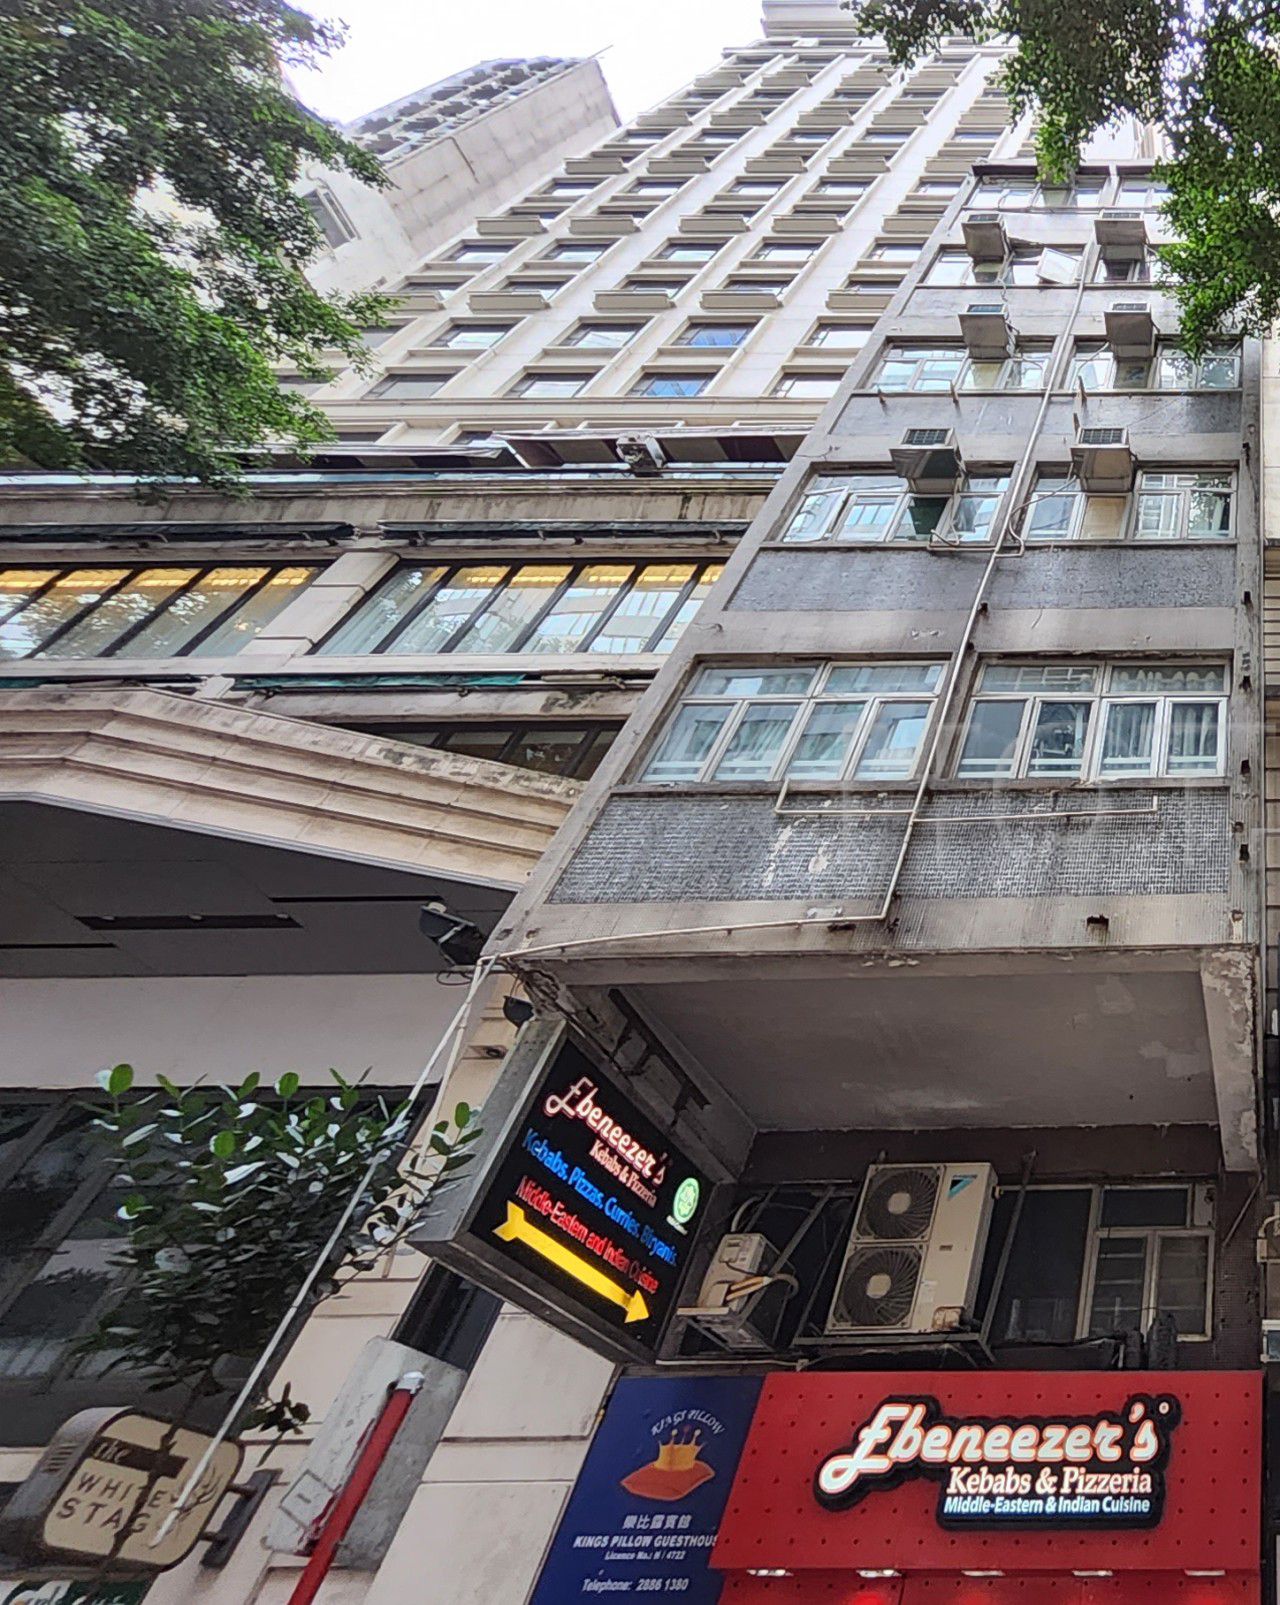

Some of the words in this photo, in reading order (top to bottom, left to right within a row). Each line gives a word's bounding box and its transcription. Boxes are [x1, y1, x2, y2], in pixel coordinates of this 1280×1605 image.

[544, 1076, 667, 1187] Ebeneezer's
[588, 1138, 622, 1177] Kebabs
[618, 1164, 630, 1184] &
[626, 1170, 658, 1209] Pizzeria
[515, 1175, 589, 1245] Middle-Eastern
[586, 1231, 607, 1257] and
[602, 1240, 631, 1274] Indian
[687, 1408, 726, 1435] PILLOW
[818, 1401, 1159, 1494] Ebeneezer's
[946, 1466, 1032, 1495] Kebabs
[1034, 1466, 1059, 1495] &
[1060, 1466, 1153, 1495] Pizzeria
[943, 1496, 1044, 1514] Middle-Eastern
[1044, 1496, 1059, 1513] &
[1058, 1496, 1100, 1513] Indian
[1101, 1496, 1151, 1513] Cuisine
[572, 1535, 610, 1548] KINGS
[609, 1535, 653, 1548] PILLOW
[582, 1578, 633, 1593] Telephone:
